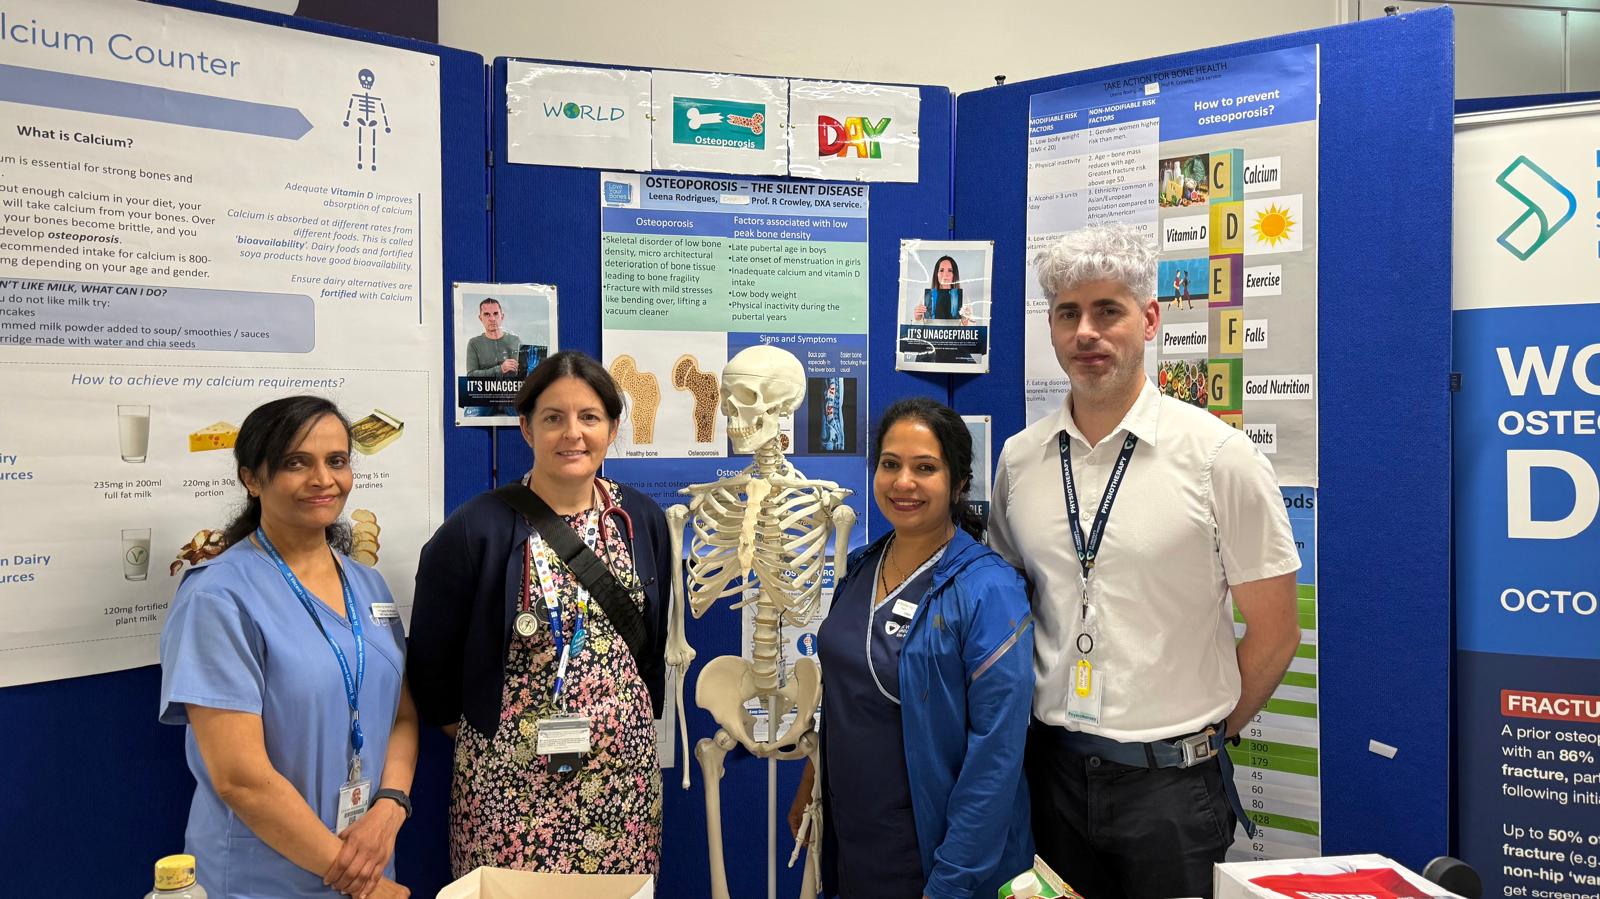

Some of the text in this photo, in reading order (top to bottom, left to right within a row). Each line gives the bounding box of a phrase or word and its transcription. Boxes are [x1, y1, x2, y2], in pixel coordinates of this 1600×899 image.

[108, 34, 240, 77] Counter
[1104, 81, 1120, 91] TAKE
[1123, 76, 1152, 86] ACTION
[1154, 72, 1170, 81] FOR
[1172, 68, 1194, 79] BONE
[1196, 62, 1227, 74] HEALTH
[1194, 90, 1280, 112] How to prevent
[543, 102, 624, 121] WORLD
[1089, 102, 1140, 115] NON-MODIFIABLE
[1198, 105, 1275, 125] osteoporosis?
[1030, 116, 1064, 125] MODIFIABLE
[1089, 115, 1114, 123] FACTORS
[17, 125, 133, 148] What is Calcium?
[694, 136, 756, 149] Osteoporosis
[818, 115, 891, 159] DAY
[20, 156, 28, 165] is
[32, 160, 80, 170] essential
[84, 163, 100, 172] for
[103, 166, 136, 179] strong
[140, 169, 170, 181] bones
[174, 174, 192, 183] and
[1214, 162, 1224, 188] C
[1244, 166, 1278, 184] Calcium
[285, 183, 328, 194] Adequate
[331, 187, 364, 198] Vitamin
[376, 193, 412, 204] improves
[646, 177, 864, 196] OSTEOPOROSIS THE SILENT DISEASE
[676, 194, 718, 204] Rodrigues,
[780, 198, 812, 208] Crowley,
[636, 218, 695, 228] Osteoporosis
[734, 216, 764, 225] Factors
[766, 218, 810, 227] associated
[833, 220, 848, 228] low
[1227, 213, 1238, 240] D
[48, 232, 122, 244] osteoporosis.
[734, 230, 754, 239] peak
[781, 230, 811, 240] density
[1167, 226, 1206, 243] Vitamin D
[640, 238, 672, 246] disorder
[809, 246, 826, 255] boys
[1214, 268, 1222, 294] E
[1247, 272, 1280, 288] Exercise
[320, 289, 358, 299] fortified
[380, 293, 412, 301] Calcium
[750, 291, 769, 299] body
[771, 291, 797, 300] weight
[924, 330, 978, 340] UNACCEPTABLE
[1164, 331, 1206, 346] Prevention
[1228, 318, 1237, 345] F
[1245, 328, 1265, 342] Falls
[760, 335, 780, 344] Signs
[798, 336, 837, 344] Symptoms
[72, 374, 345, 391] How to achieve my calcium requirements?
[1212, 374, 1222, 400] G
[1246, 380, 1309, 394] Good Nutrition
[1064, 459, 1076, 514] PHYSIOTHERAPY
[1101, 456, 1127, 514] PHYSIOTHERAPY
[195, 490, 224, 498] portion
[14, 554, 50, 565] Dairy
[135, 602, 168, 612] fortified
[116, 614, 157, 627] plant milk
[1251, 729, 1262, 737] 93
[1502, 724, 1512, 736] A
[1518, 727, 1551, 740] prior
[1251, 742, 1268, 752] 300
[1502, 746, 1594, 763] with an 86%
[1252, 757, 1268, 767] 179
[1252, 771, 1262, 780] 45
[1502, 764, 1568, 783] fracture,
[1252, 786, 1263, 794] 60
[1502, 784, 1568, 805] following
[1252, 799, 1263, 809] 80
[1252, 814, 1270, 824] 428
[1504, 824, 1524, 839] Up
[1529, 827, 1544, 839] to
[1548, 829, 1582, 843] 50%
[1253, 843, 1264, 852] 62
[1503, 844, 1565, 862] fracture
